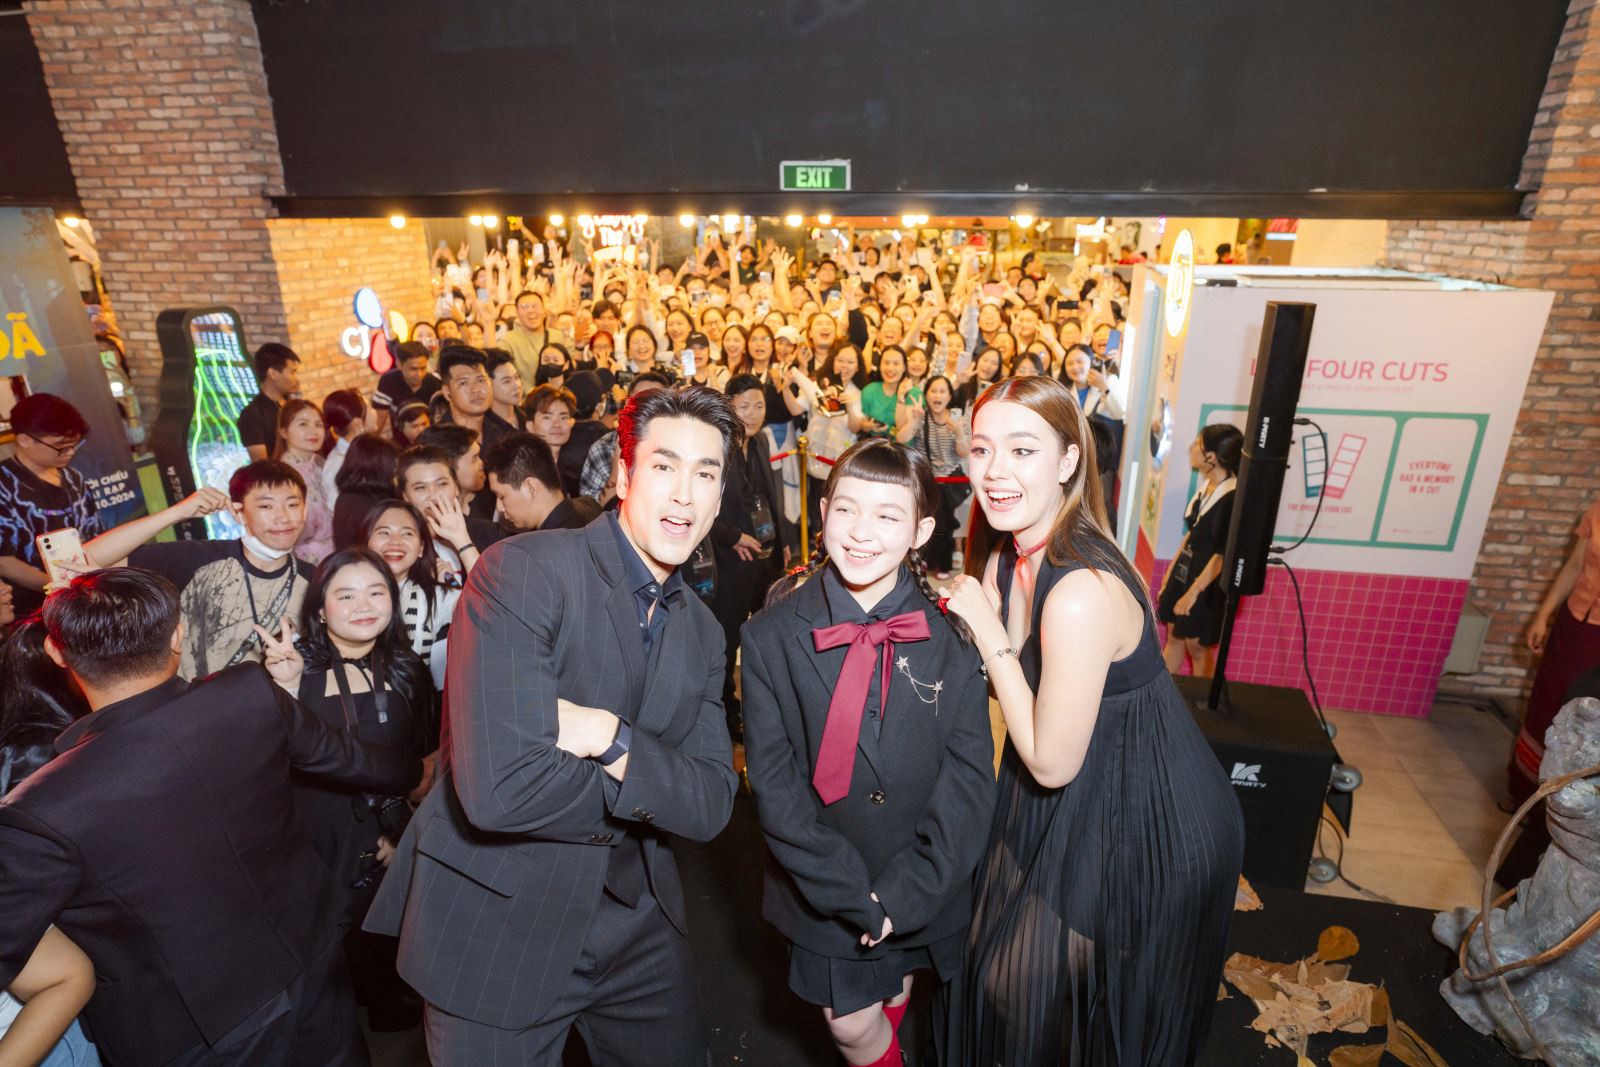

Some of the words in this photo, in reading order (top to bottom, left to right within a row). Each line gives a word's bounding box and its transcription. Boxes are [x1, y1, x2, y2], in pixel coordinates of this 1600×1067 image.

[796, 167, 833, 188] EXIT
[1307, 359, 1375, 380] FOUR
[1381, 361, 1449, 382] CUTS
[1409, 461, 1453, 472] EVERYONE
[1424, 474, 1456, 484] MEMORY
[95, 490, 136, 509] 10.2024
